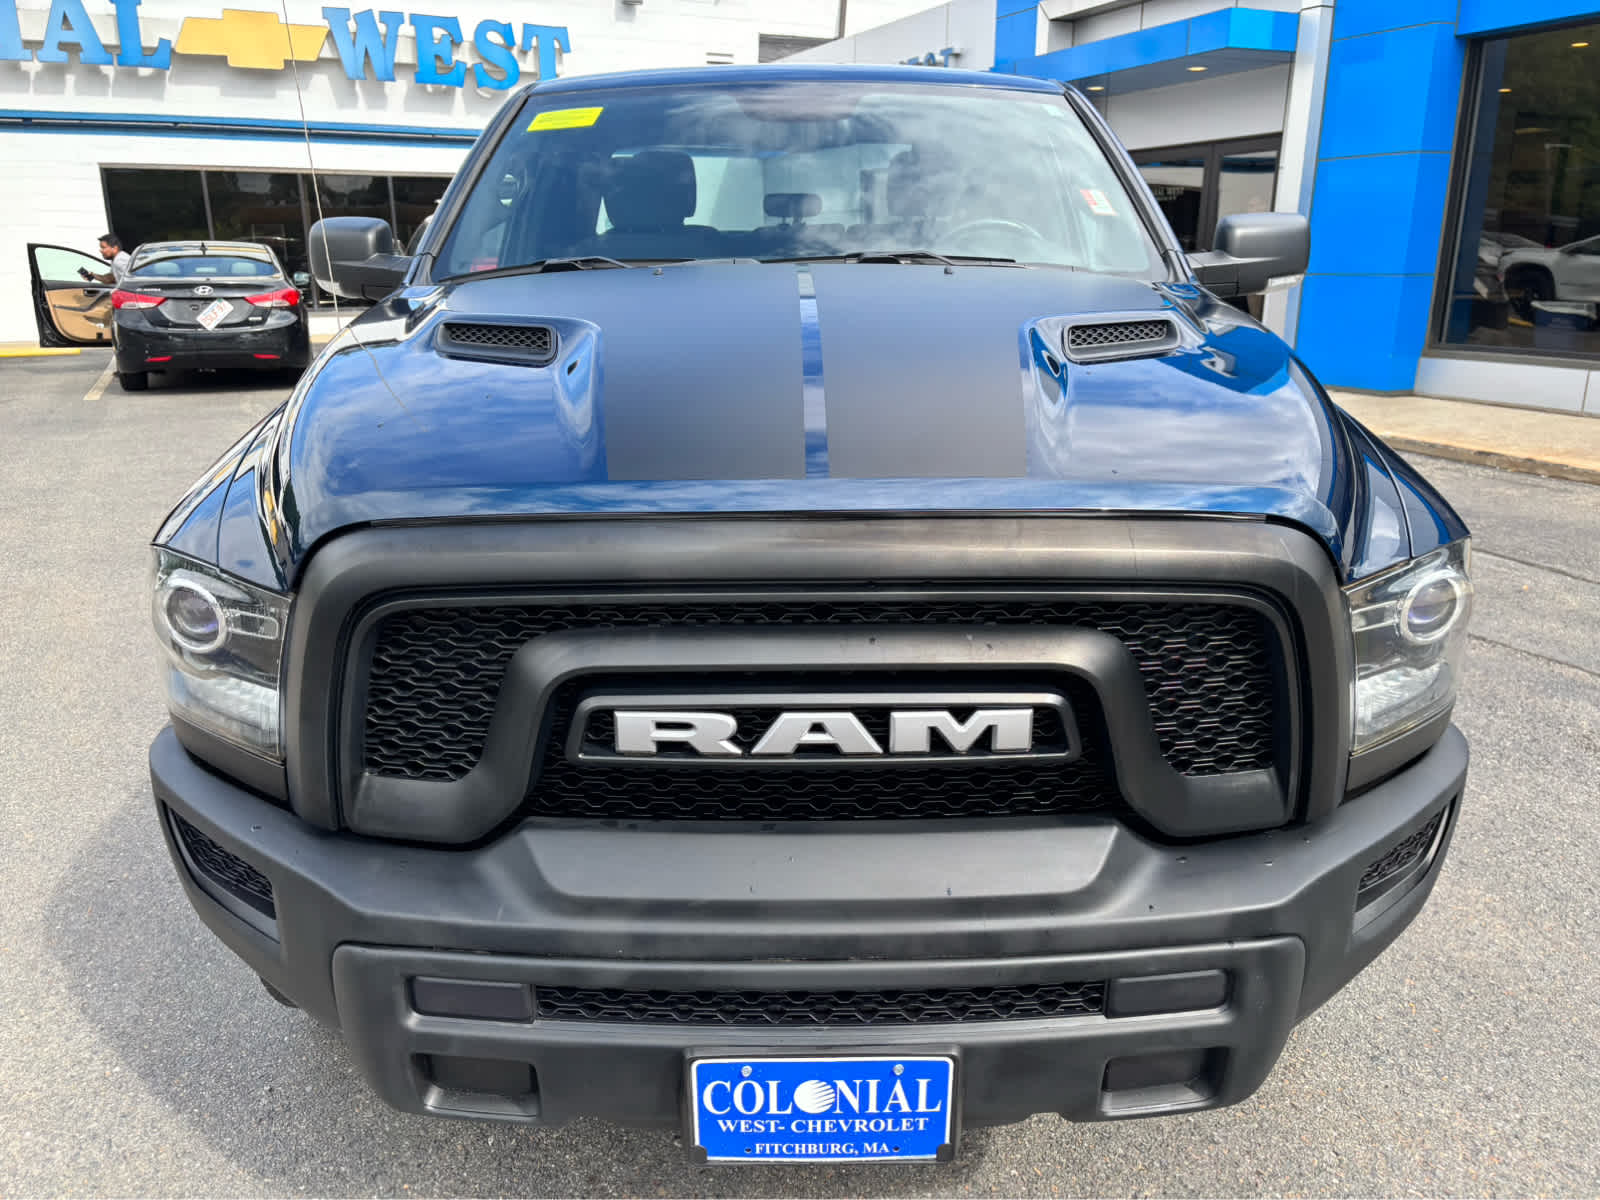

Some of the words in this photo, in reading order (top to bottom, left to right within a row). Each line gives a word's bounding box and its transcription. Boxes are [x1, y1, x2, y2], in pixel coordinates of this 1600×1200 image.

[322, 7, 571, 90] WEST
[614, 708, 1034, 755] RAM
[703, 1079, 942, 1115] COLONIAL
[717, 1119, 785, 1133] WEST-
[791, 1118, 929, 1133] CHEVROLET
[755, 1143, 859, 1155] FITCHBURG,
[863, 1142, 890, 1154] MA
